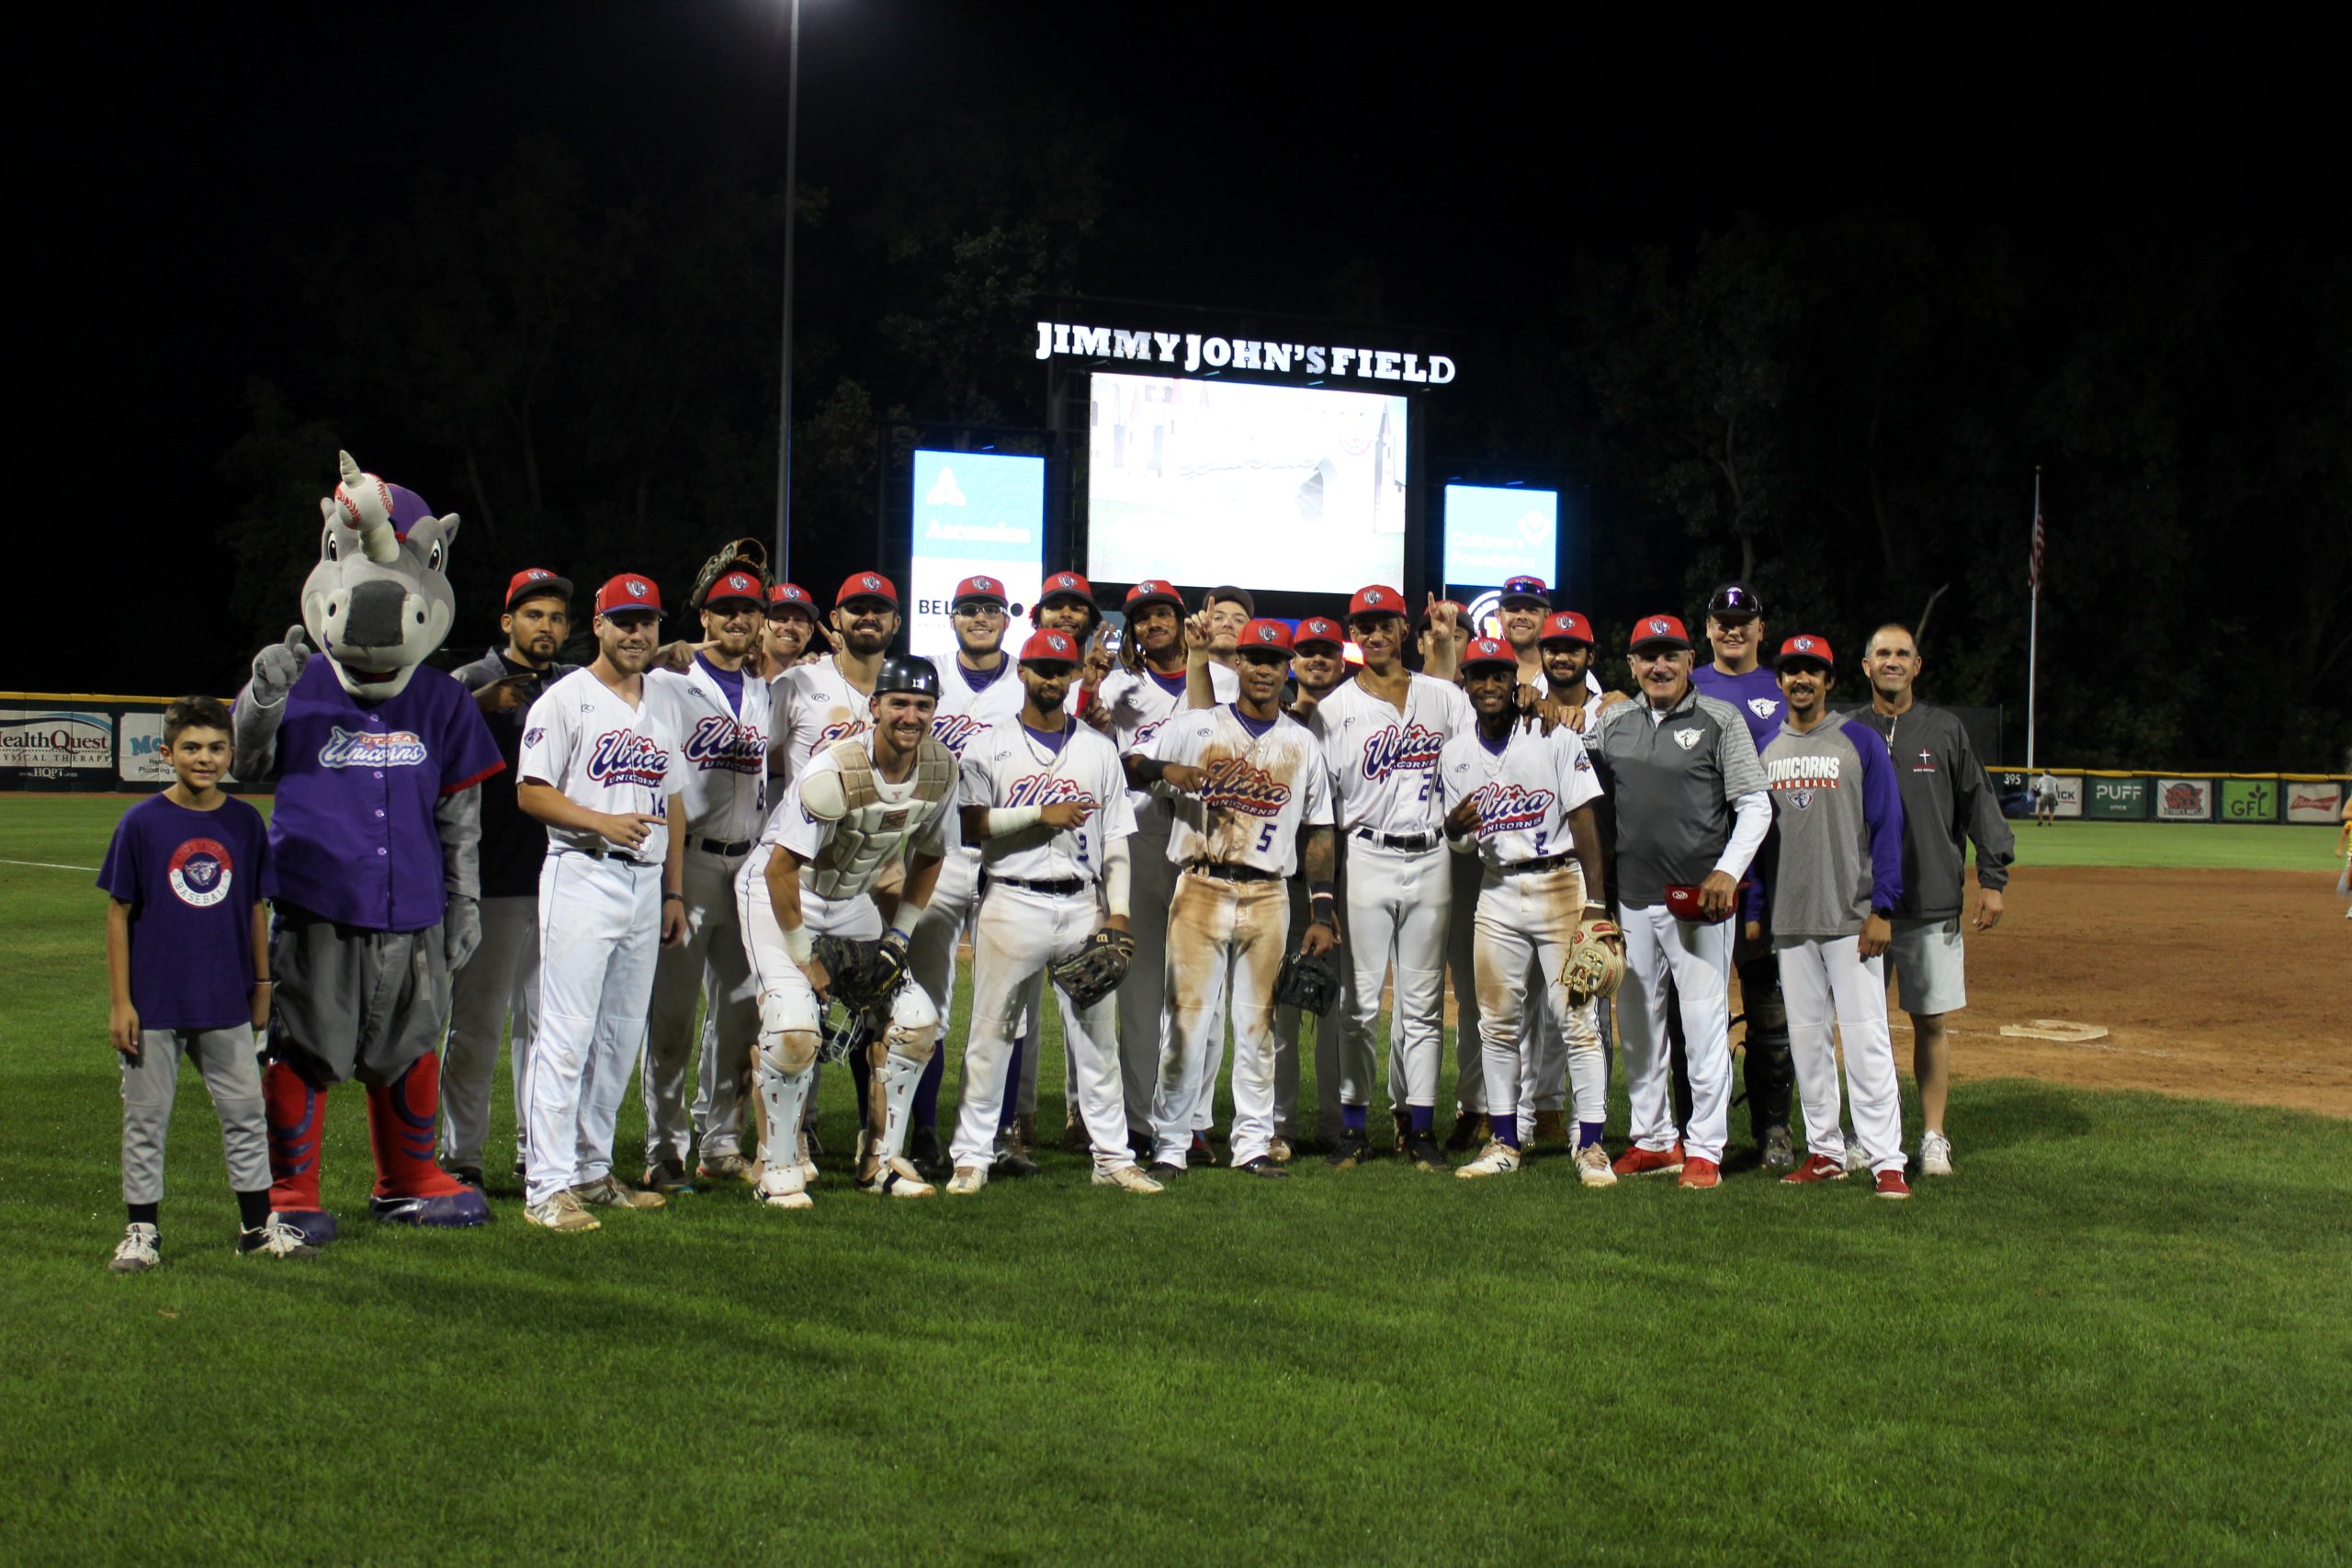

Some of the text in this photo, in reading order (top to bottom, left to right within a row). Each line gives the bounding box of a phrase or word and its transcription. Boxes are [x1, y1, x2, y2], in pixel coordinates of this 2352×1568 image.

[1035, 321, 1181, 362] JIMMY
[1330, 346, 1456, 384] FIELD
[918, 599, 953, 615] BEL
[323, 730, 422, 762] Unicorns
[587, 728, 670, 781] Utica
[1363, 724, 1444, 781] Utica
[1767, 756, 1839, 783] UNICORNS
[2004, 773, 2021, 785] 395
[1418, 773, 1443, 802] 24
[2096, 785, 2142, 800] PUFF
[2231, 792, 2267, 817] GFL
[1256, 823, 1278, 852] 5
[1481, 818, 1542, 837] UNICORNS
[1535, 830, 1549, 857] 2
